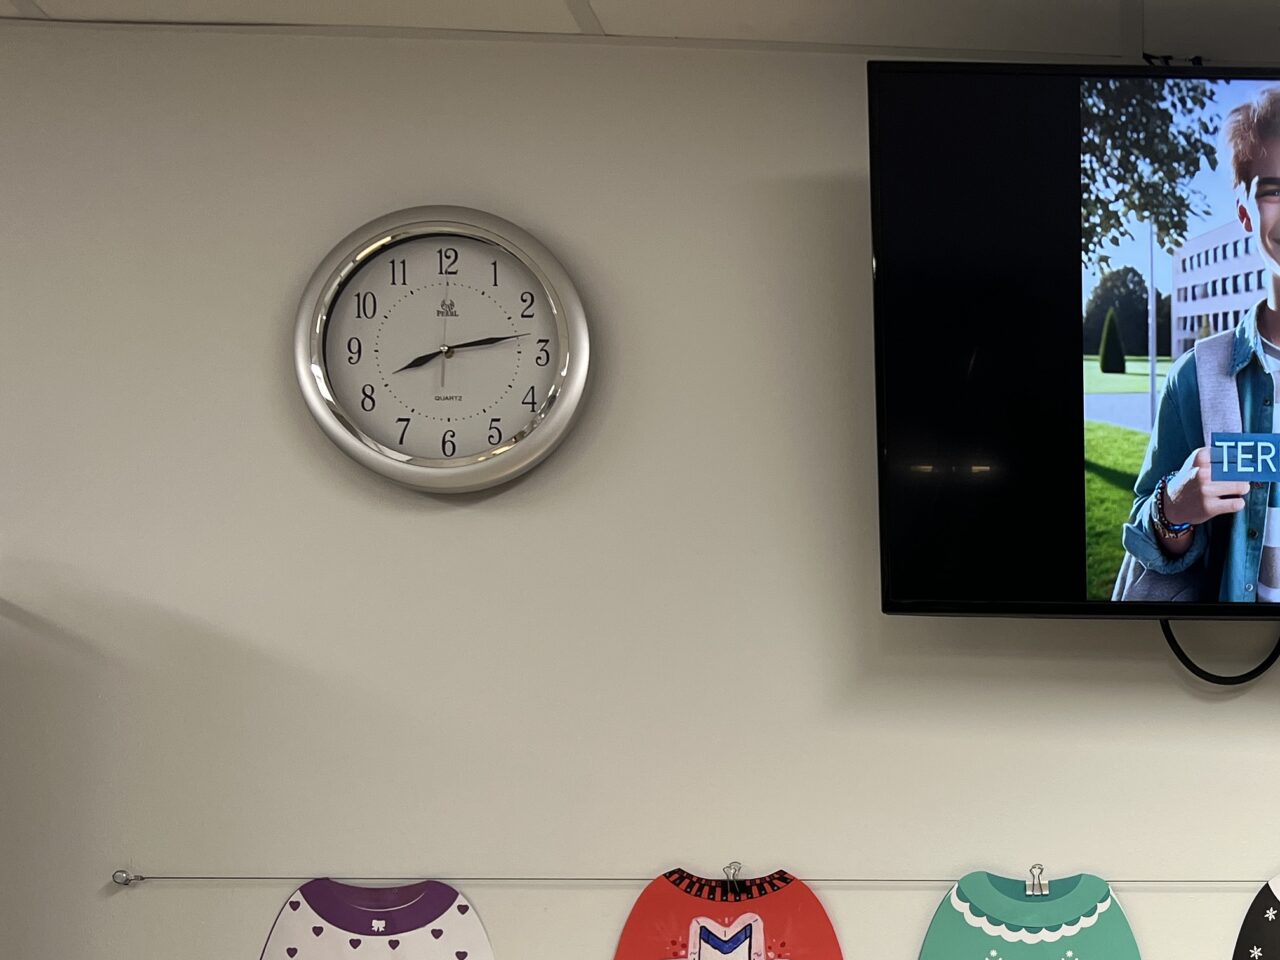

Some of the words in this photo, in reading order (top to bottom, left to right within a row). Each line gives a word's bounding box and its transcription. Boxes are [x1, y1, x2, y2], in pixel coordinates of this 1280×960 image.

[389, 259, 408, 286] 11
[436, 248, 459, 275] 12
[490, 260, 499, 287] 1
[354, 291, 377, 319] 10
[519, 291, 535, 319] 2
[347, 337, 362, 365] 9
[535, 338, 550, 367] 3
[360, 384, 376, 412] 8
[521, 386, 538, 413] 4
[395, 418, 411, 445] 7
[441, 430, 456, 457] 6
[487, 418, 502, 445] 5
